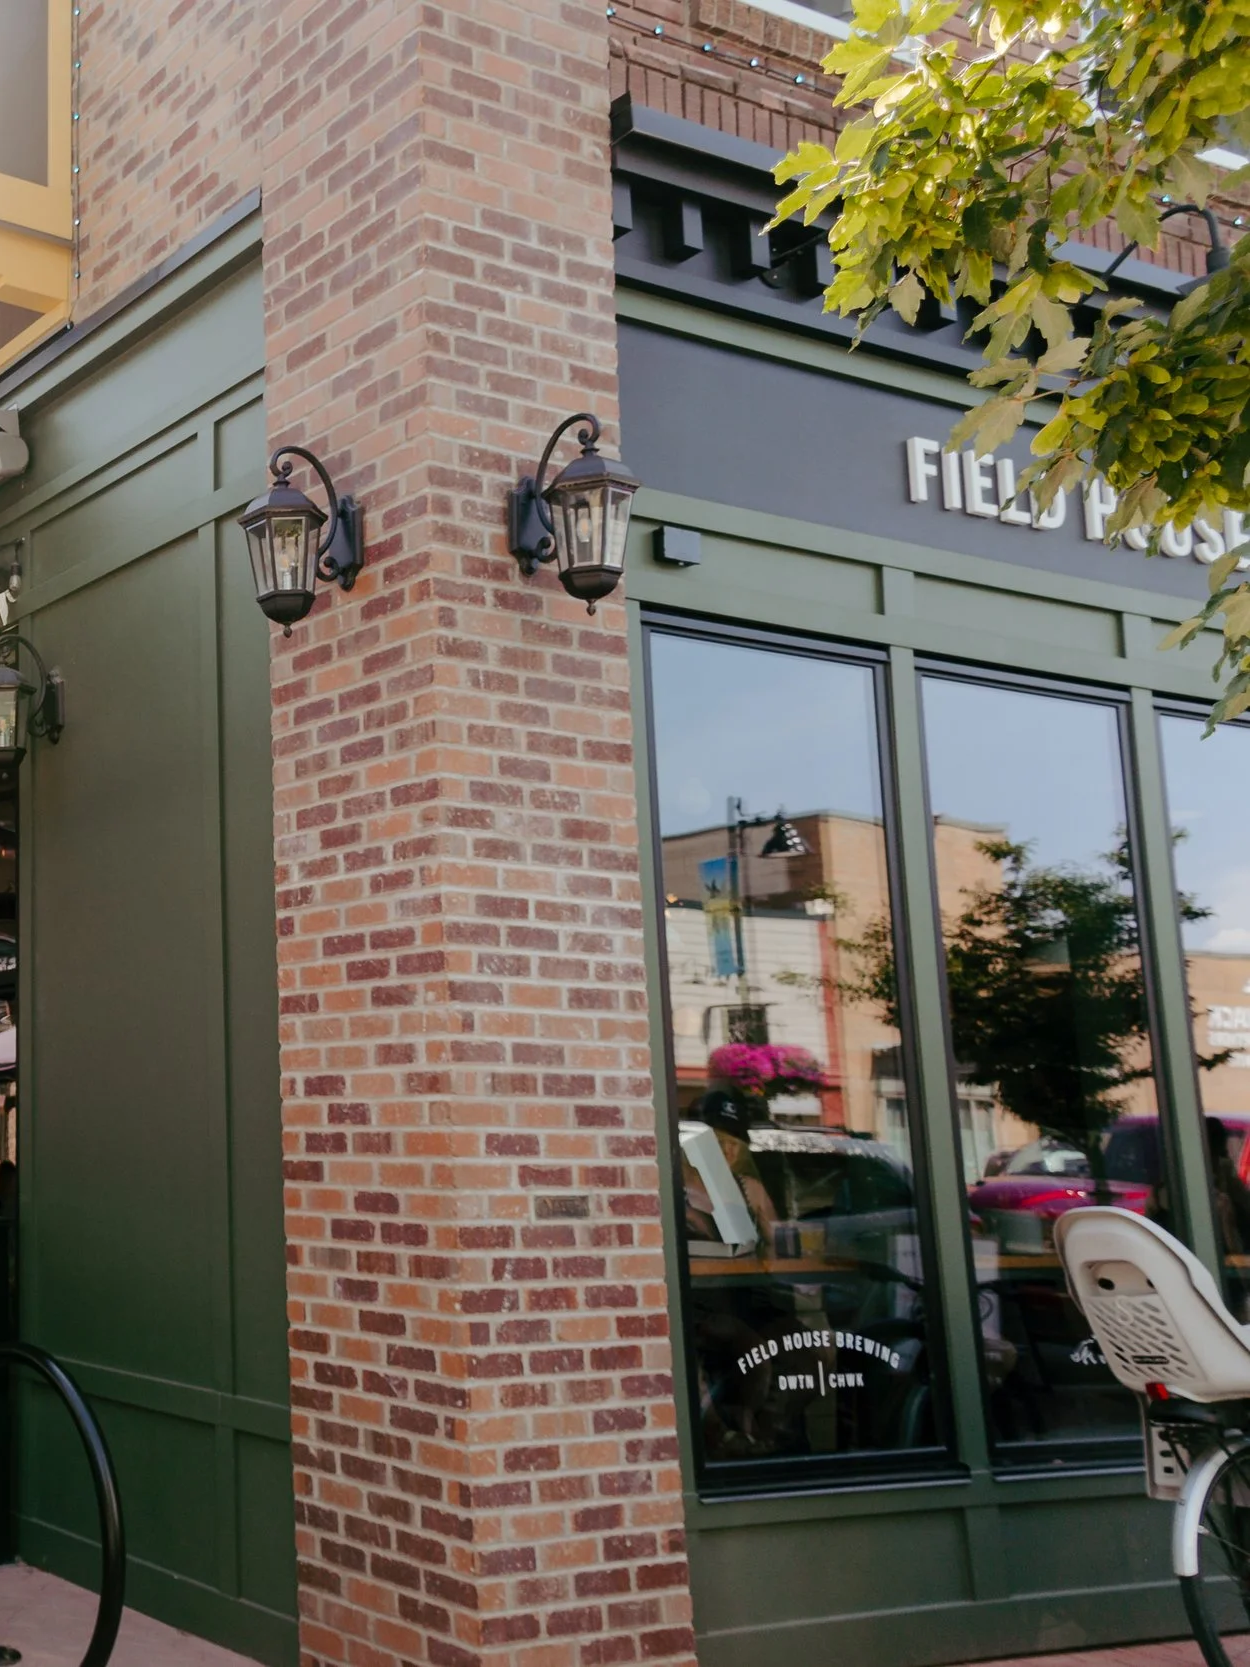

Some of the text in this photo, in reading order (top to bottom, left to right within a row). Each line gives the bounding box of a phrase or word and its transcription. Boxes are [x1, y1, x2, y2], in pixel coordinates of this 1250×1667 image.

[736, 1330, 901, 1375] FIELD HOUSE BREWING
[778, 1372, 865, 1391] DWTN CHWK
